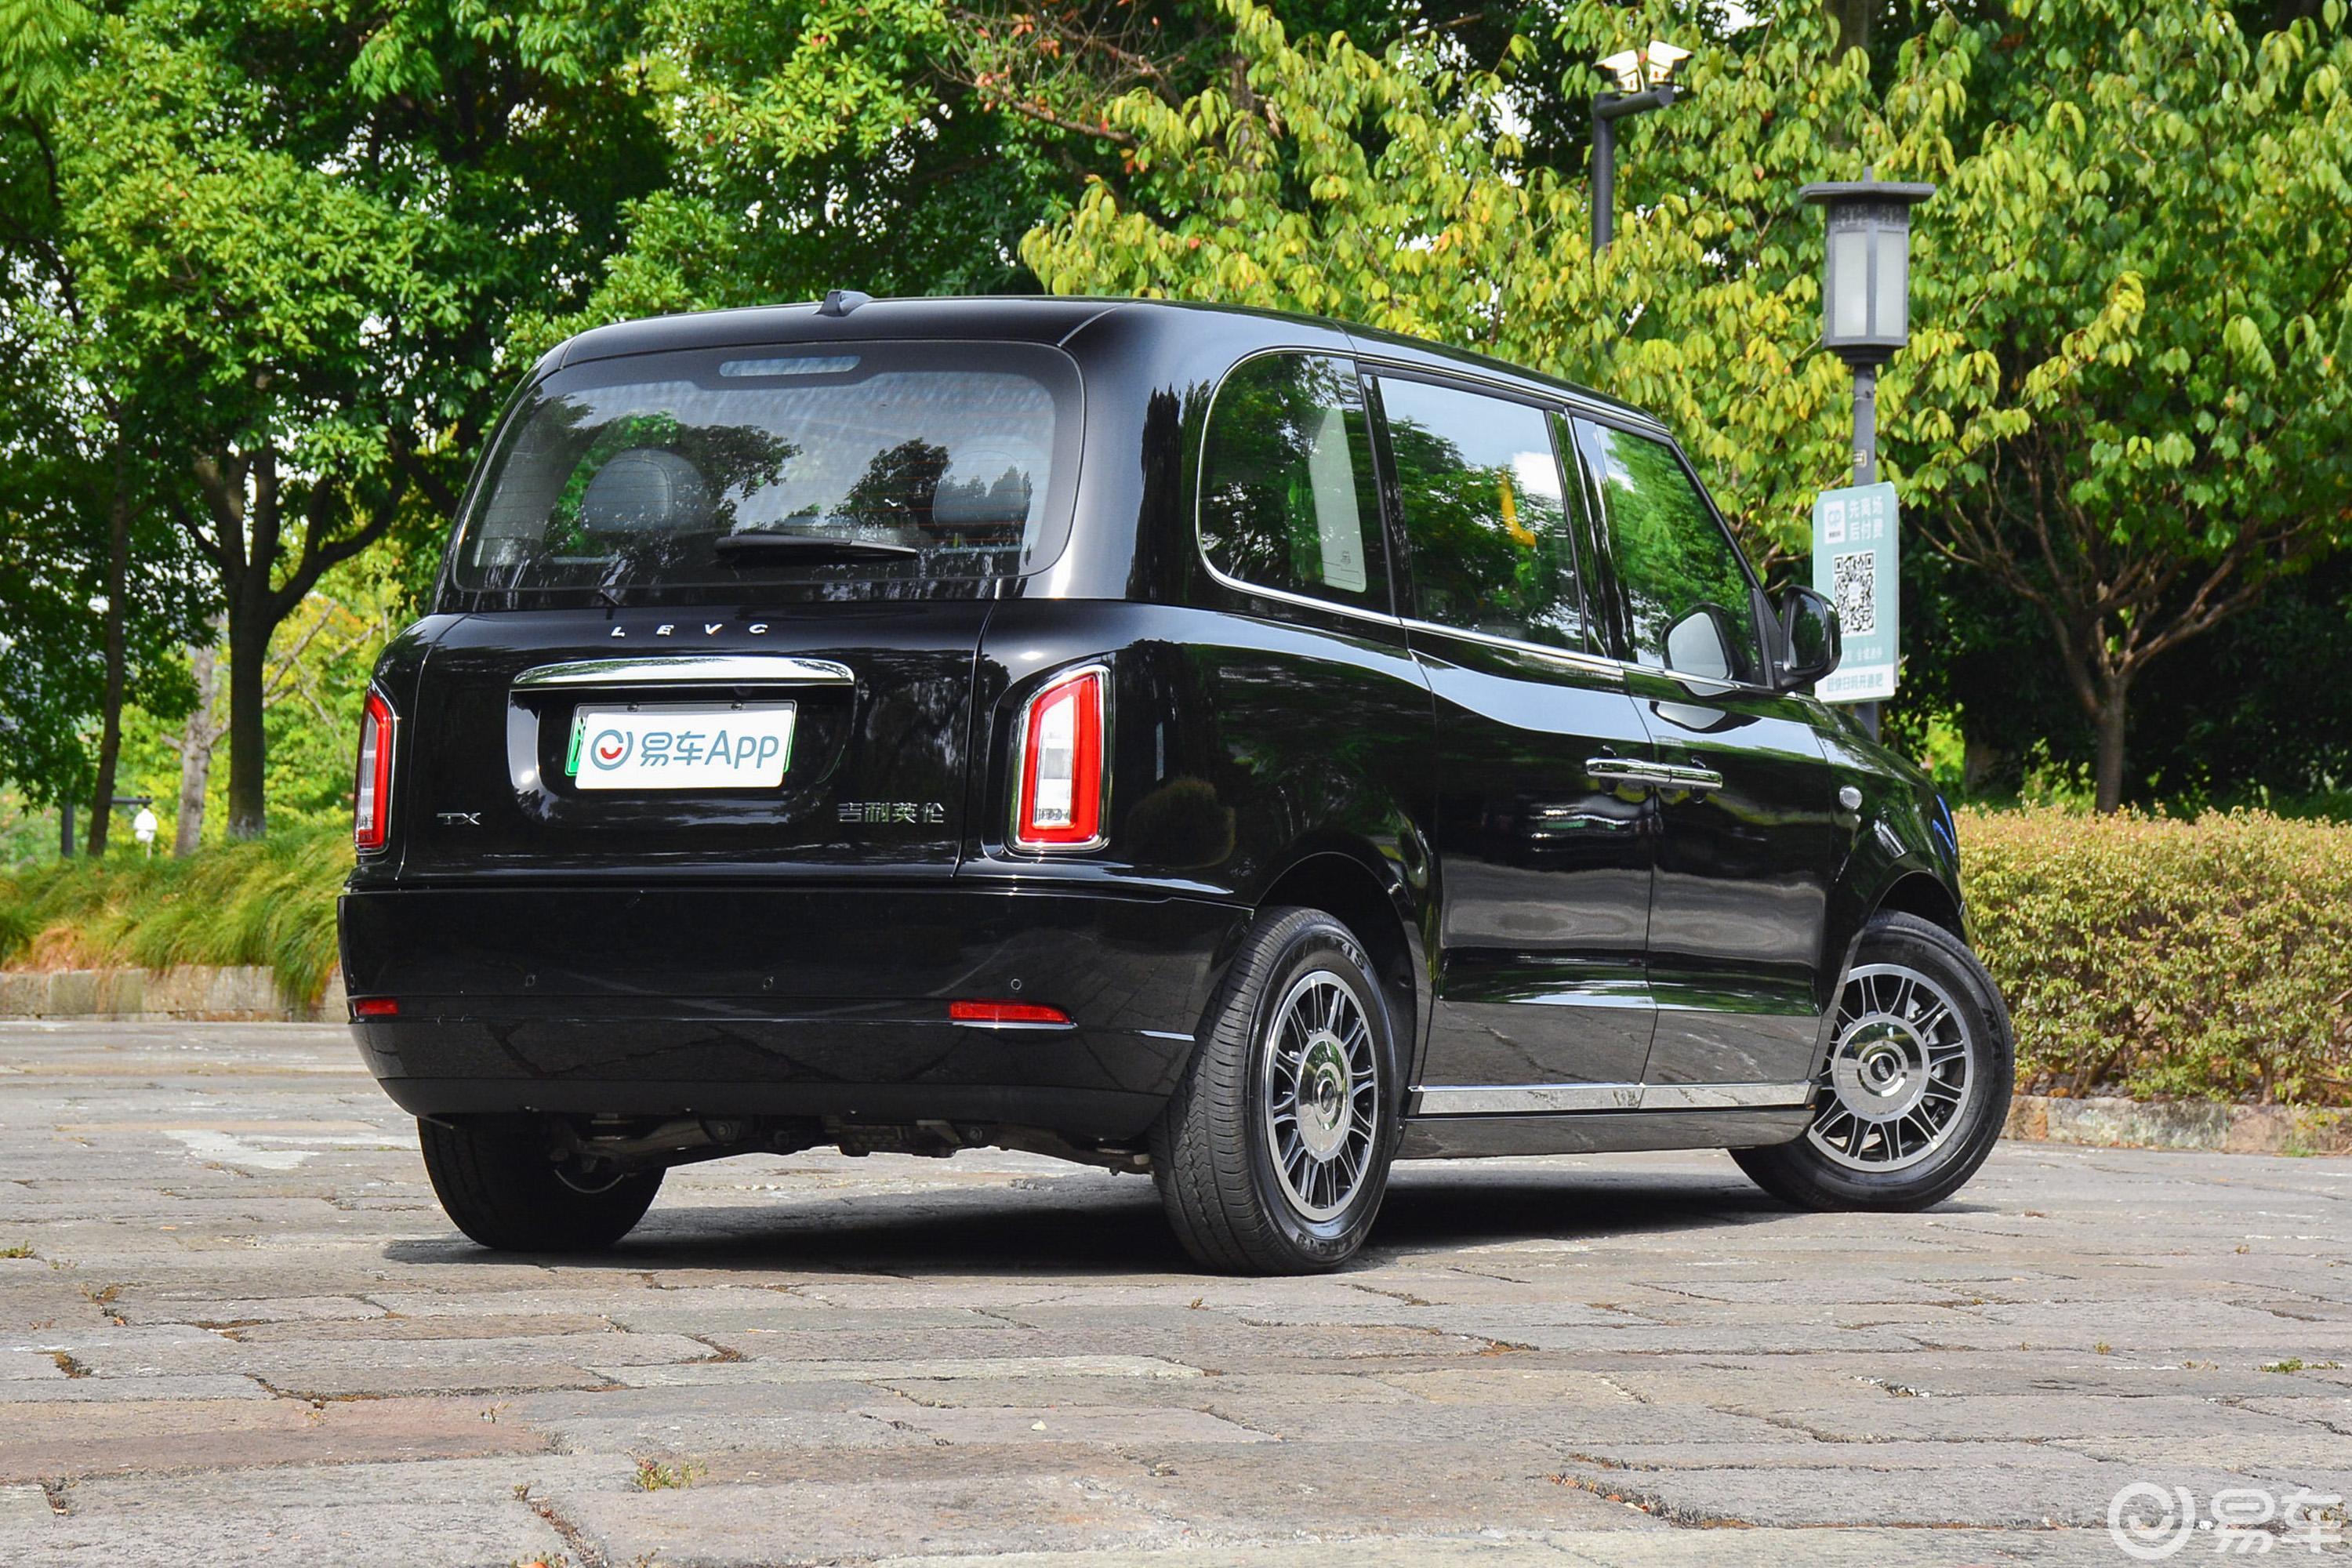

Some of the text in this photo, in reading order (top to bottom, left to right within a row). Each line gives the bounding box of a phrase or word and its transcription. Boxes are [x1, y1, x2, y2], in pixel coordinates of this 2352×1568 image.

[1849, 495, 1883, 518] 先离场
[1849, 518, 1884, 541] 后付费
[611, 623, 768, 637] LEVC
[640, 730, 779, 769] 易车App
[437, 812, 481, 825] TX
[837, 802, 945, 823] 吉利英伦
